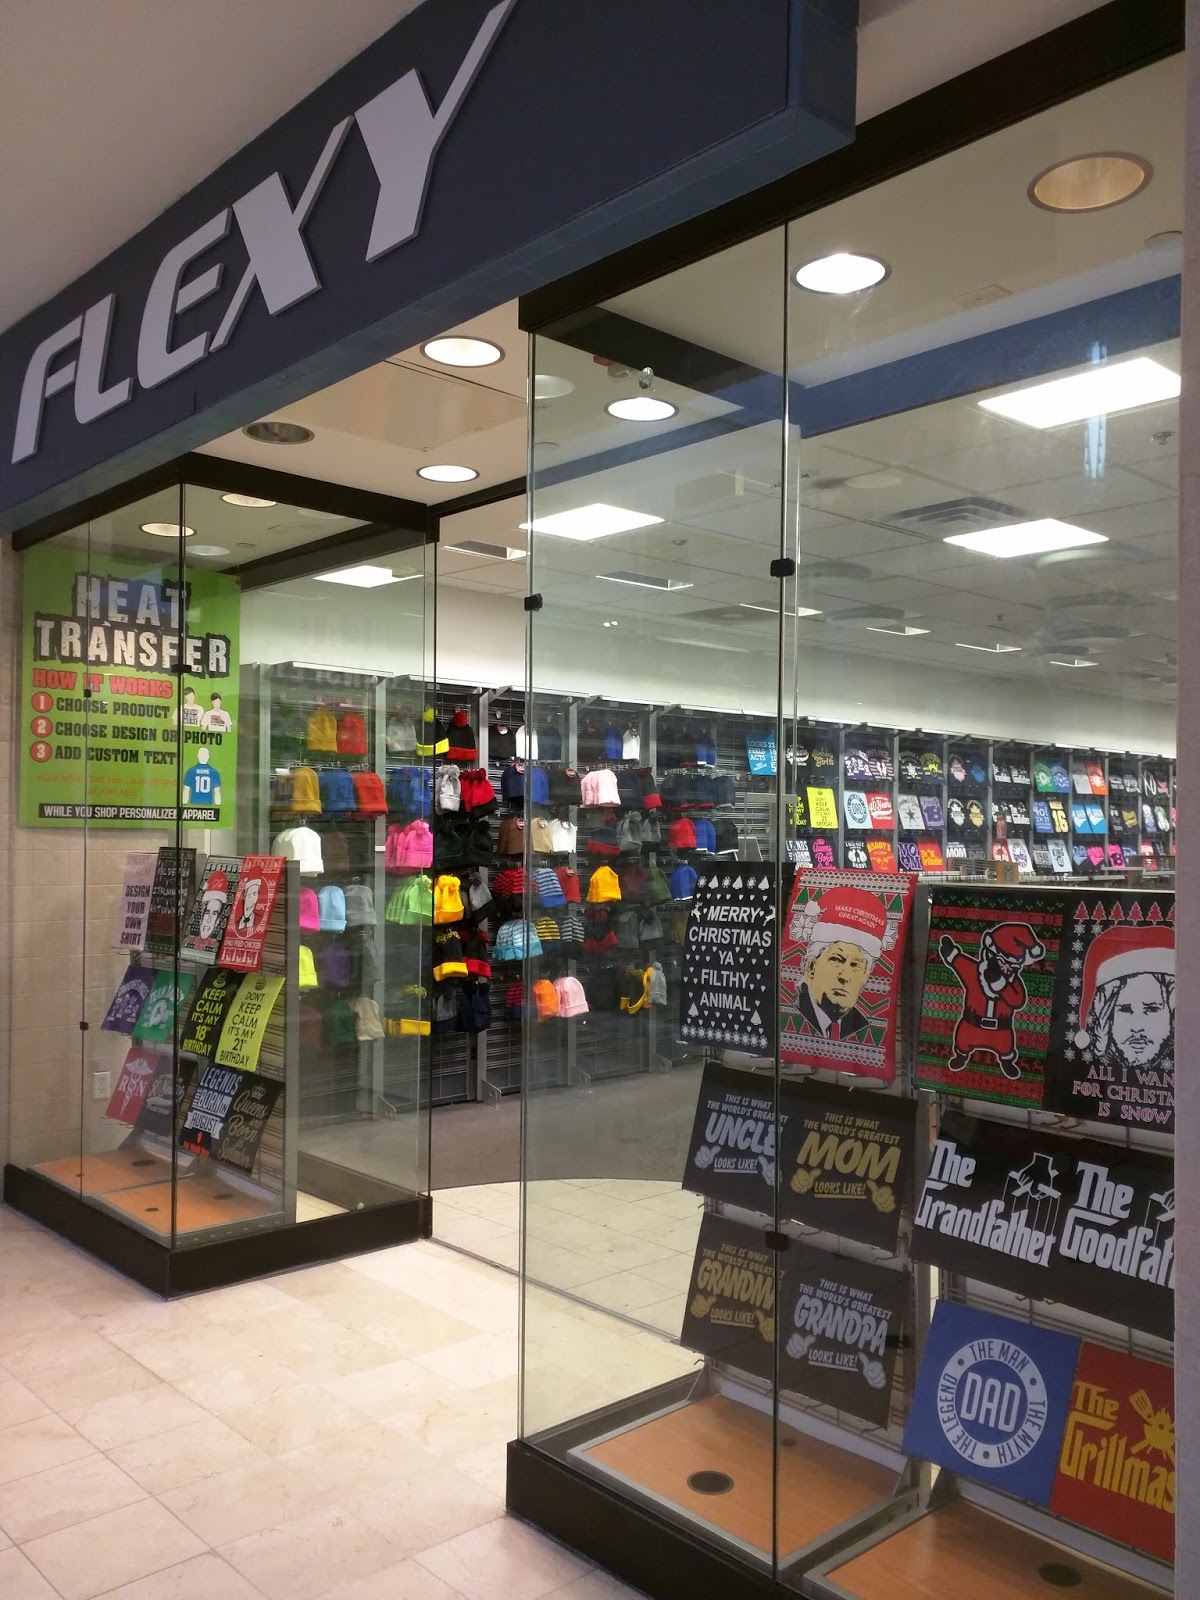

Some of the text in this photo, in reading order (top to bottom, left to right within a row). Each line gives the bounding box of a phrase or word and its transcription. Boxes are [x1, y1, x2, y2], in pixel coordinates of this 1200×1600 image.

[10, 0, 516, 464] FLEXY
[75, 574, 187, 629] HEAT
[36, 618, 227, 673] TRANSFER
[32, 668, 173, 698] HOW IT WORKS
[56, 696, 108, 715] CHOOSE
[113, 701, 170, 719] PRODUCT
[55, 721, 107, 739] CHOOSE
[112, 725, 157, 742] DESIGN
[162, 728, 178, 744] OR
[184, 730, 222, 746] PHOTO
[54, 746, 81, 761] ADD
[87, 747, 139, 763] CUSTOM
[144, 751, 177, 766] TEXT
[194, 776, 211, 794] 10
[44, 805, 72, 817] WHILE
[75, 806, 92, 817] YOU
[94, 807, 117, 818] SHOP
[183, 809, 216, 820] APPAREL
[125, 885, 151, 898] DESIGN
[127, 901, 146, 914] YOUR
[707, 905, 760, 923] MERRY
[835, 905, 885, 926] MAKE CHRISTMAS
[125, 916, 142, 930] OWN
[838, 911, 878, 929] GREAT AGAIN
[120, 931, 142, 946] SHIRT
[688, 926, 772, 948] CHRISTMAS
[718, 951, 735, 966] YA
[701, 969, 750, 990] FILTHY
[202, 987, 227, 1001] KEEP
[700, 992, 751, 1012] ANIMAL
[191, 1012, 220, 1025] IT'S MY
[196, 1000, 223, 1015] CALM
[238, 1001, 261, 1015] KEEP
[232, 1014, 259, 1028] CALM
[195, 1025, 211, 1041] 18
[227, 1026, 255, 1039] IT'S MY
[182, 1039, 212, 1056] BIRTHDAY
[232, 1038, 247, 1052] 21
[219, 1050, 250, 1067] BIRTHDAY
[200, 1066, 243, 1095] LEGENDS
[1087, 1065, 1174, 1088] ALL I WAN
[199, 1088, 224, 1113] BORN
[233, 1090, 269, 1119] Queens
[725, 1093, 772, 1110] THIS IS WHAT
[1072, 1080, 1174, 1107] FOR CHRISTM
[191, 1112, 218, 1132] AUGUST
[707, 1100, 789, 1124] THE WORLD'S GREATST
[825, 1112, 880, 1131] THIS IS WHAT
[1098, 1101, 1172, 1125] IS SNOW
[228, 1114, 259, 1142] Born
[705, 1111, 783, 1157] UNCLE
[803, 1119, 901, 1146] THE WORLD'S GREATEST
[713, 1157, 758, 1170] LOOKS LIKE!
[797, 1131, 902, 1183] MOM
[927, 1138, 977, 1188] The
[814, 1180, 866, 1195] LOOKS LIKE!
[1074, 1160, 1135, 1219] The
[914, 1177, 1056, 1267] Grandfather
[721, 1243, 768, 1263] THIS IS WHAT
[1059, 1207, 1175, 1290] Goodfat
[702, 1247, 786, 1279] THE WORLD'S GREATT
[799, 1283, 893, 1320] THE WORLD'S GREATEST
[820, 1278, 874, 1303] THIS IS WHAT
[710, 1307, 755, 1325] LOOKS LIKE!
[793, 1294, 889, 1356] GRANDPA
[808, 1348, 858, 1367] LOOKS LIKE!
[969, 1339, 1031, 1373] THE MAN
[960, 1371, 1021, 1433] DAD
[1074, 1380, 1119, 1421] The
[938, 1372, 976, 1460] THE LEGEND
[996, 1399, 1046, 1465] THE MYTH
[1059, 1410, 1175, 1514] Grillmas
